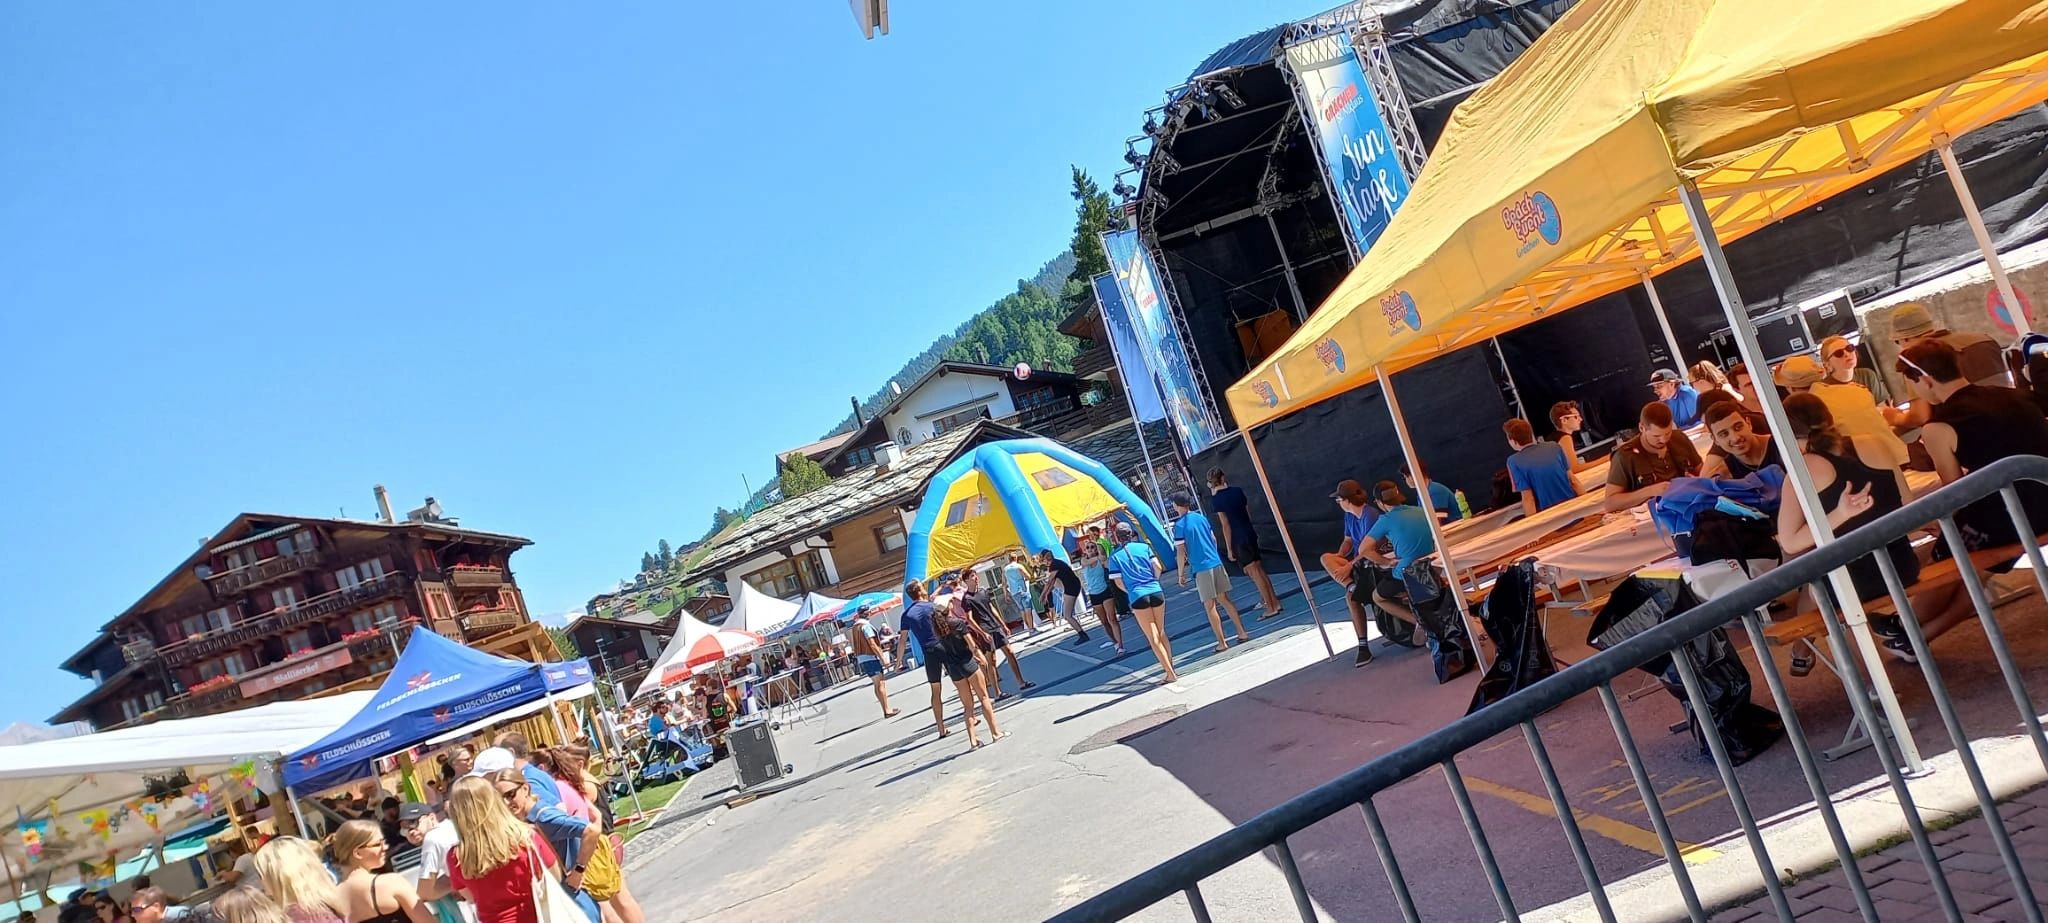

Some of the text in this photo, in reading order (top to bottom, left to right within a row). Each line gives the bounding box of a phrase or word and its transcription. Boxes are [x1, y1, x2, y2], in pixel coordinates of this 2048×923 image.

[1502, 191, 1534, 230] Beach
[1513, 203, 1546, 244] Event
[376, 672, 462, 711] FELDSCHLÖSSCHEN
[453, 683, 522, 714] FELDSCHLÖSSCHEN
[321, 729, 391, 761] FELDSCHLÖSSCHEN
